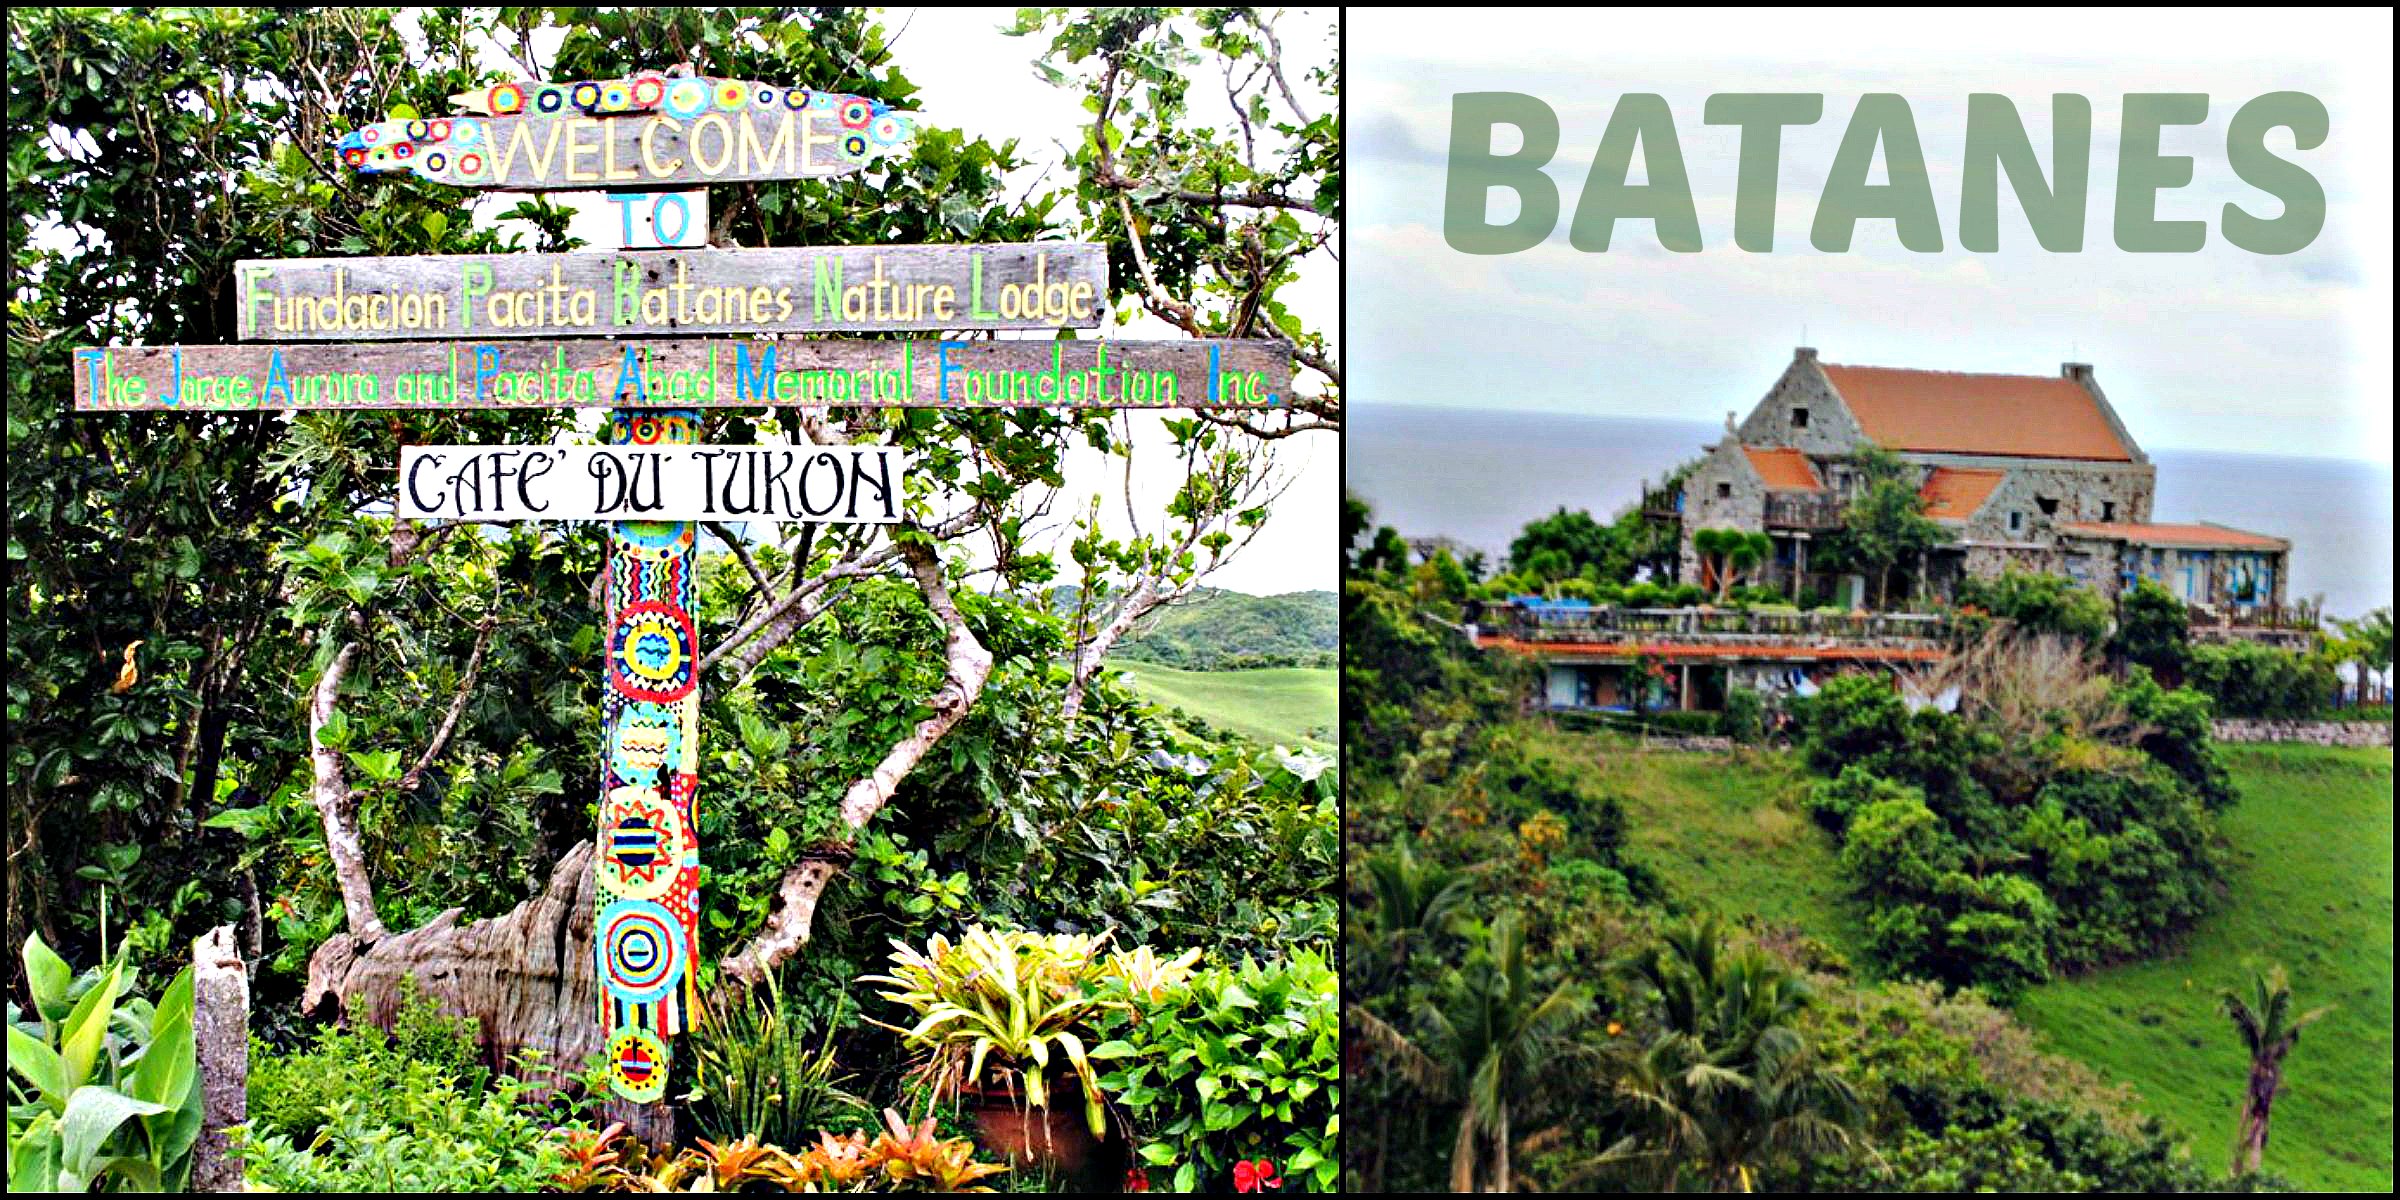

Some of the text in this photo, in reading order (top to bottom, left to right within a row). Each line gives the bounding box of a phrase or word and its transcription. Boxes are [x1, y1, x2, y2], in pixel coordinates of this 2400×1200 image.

[482, 108, 838, 183] WELCOME
[606, 192, 690, 247] TO
[245, 253, 1093, 334] Fundacion Pacita Batanes Nature Lodge
[76, 348, 147, 407] The
[261, 346, 379, 405] Aurora
[395, 343, 457, 404] and
[474, 345, 596, 405] Pacita
[616, 344, 717, 406] Abad
[735, 342, 914, 403] Memorial
[937, 341, 1178, 404] Foundation
[1207, 342, 1280, 405] Inc.
[691, 448, 897, 519] TUKON
